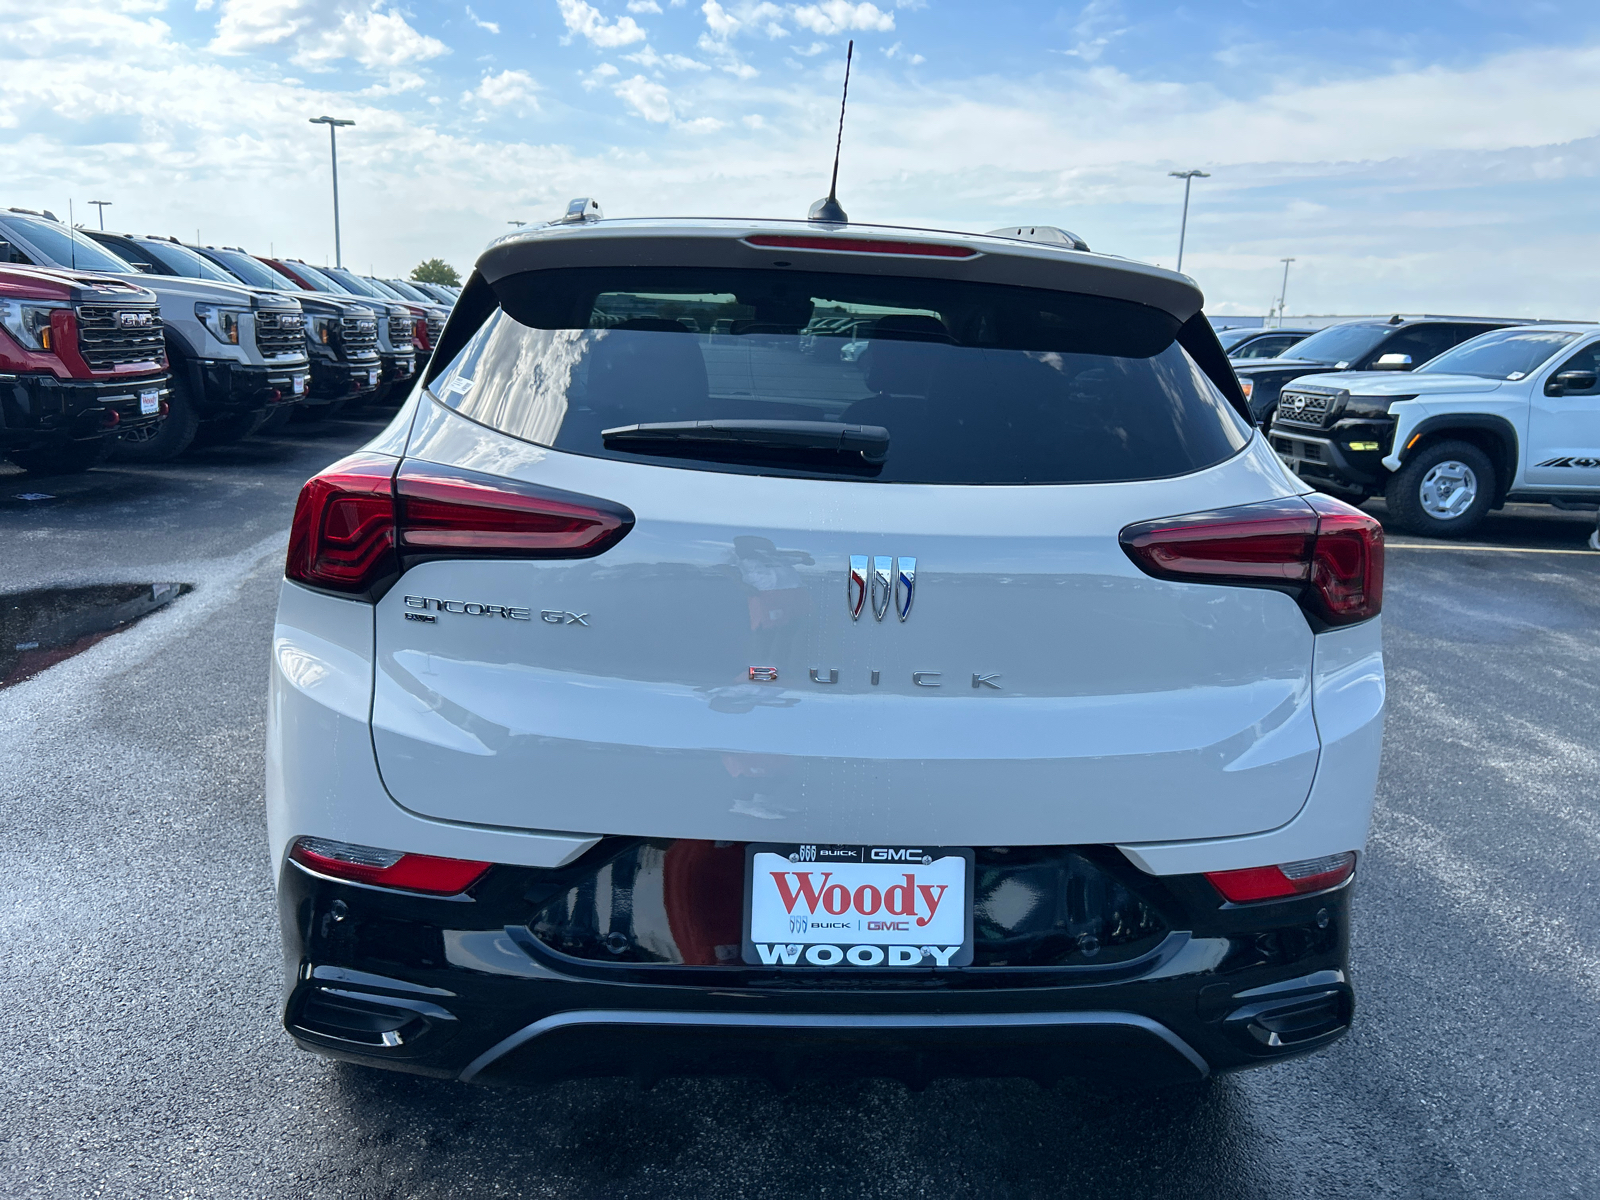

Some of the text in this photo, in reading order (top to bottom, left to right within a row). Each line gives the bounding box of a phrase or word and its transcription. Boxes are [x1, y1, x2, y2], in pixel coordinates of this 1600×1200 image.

[121, 313, 153, 327] GMC
[404, 594, 590, 626] ENCORE GX
[749, 666, 1002, 689] BUICK
[820, 848, 923, 861] BUICK GMC
[769, 871, 949, 927] Woody
[867, 921, 909, 931] GMC
[755, 944, 961, 967] WOODY
